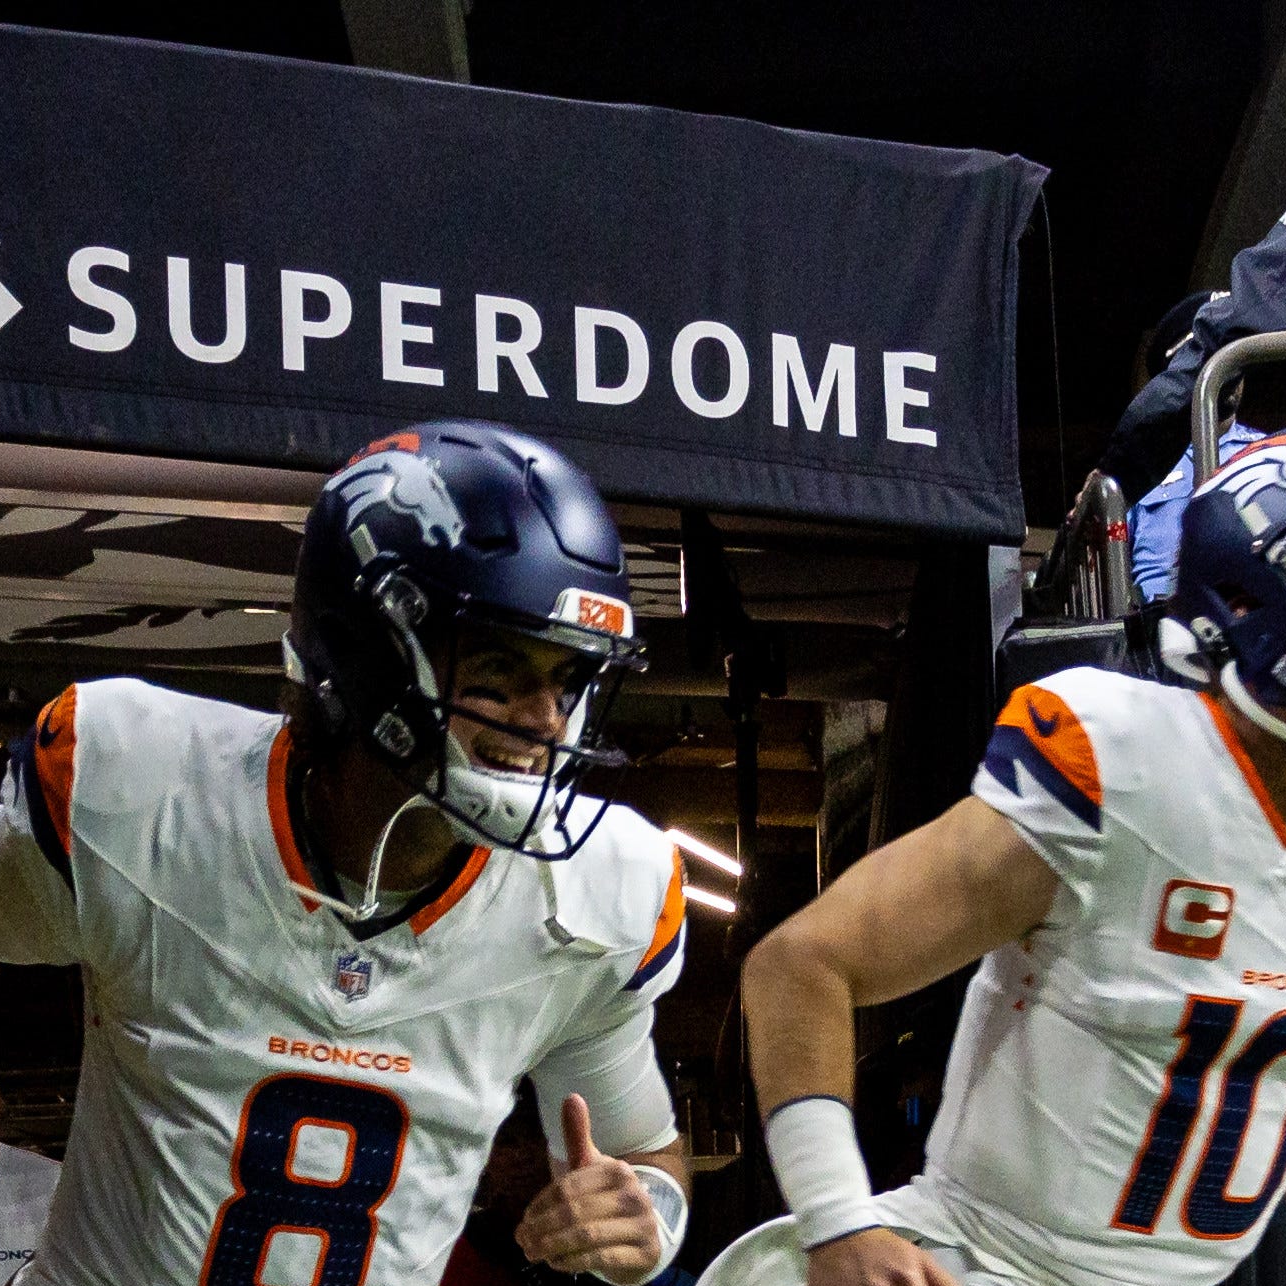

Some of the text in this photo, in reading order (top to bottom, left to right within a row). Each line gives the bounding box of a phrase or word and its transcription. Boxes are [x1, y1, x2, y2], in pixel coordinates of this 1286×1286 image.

[66, 246, 939, 447] SUPERDOME
[1166, 886, 1231, 939] C
[268, 1035, 412, 1074] BRONCOS
